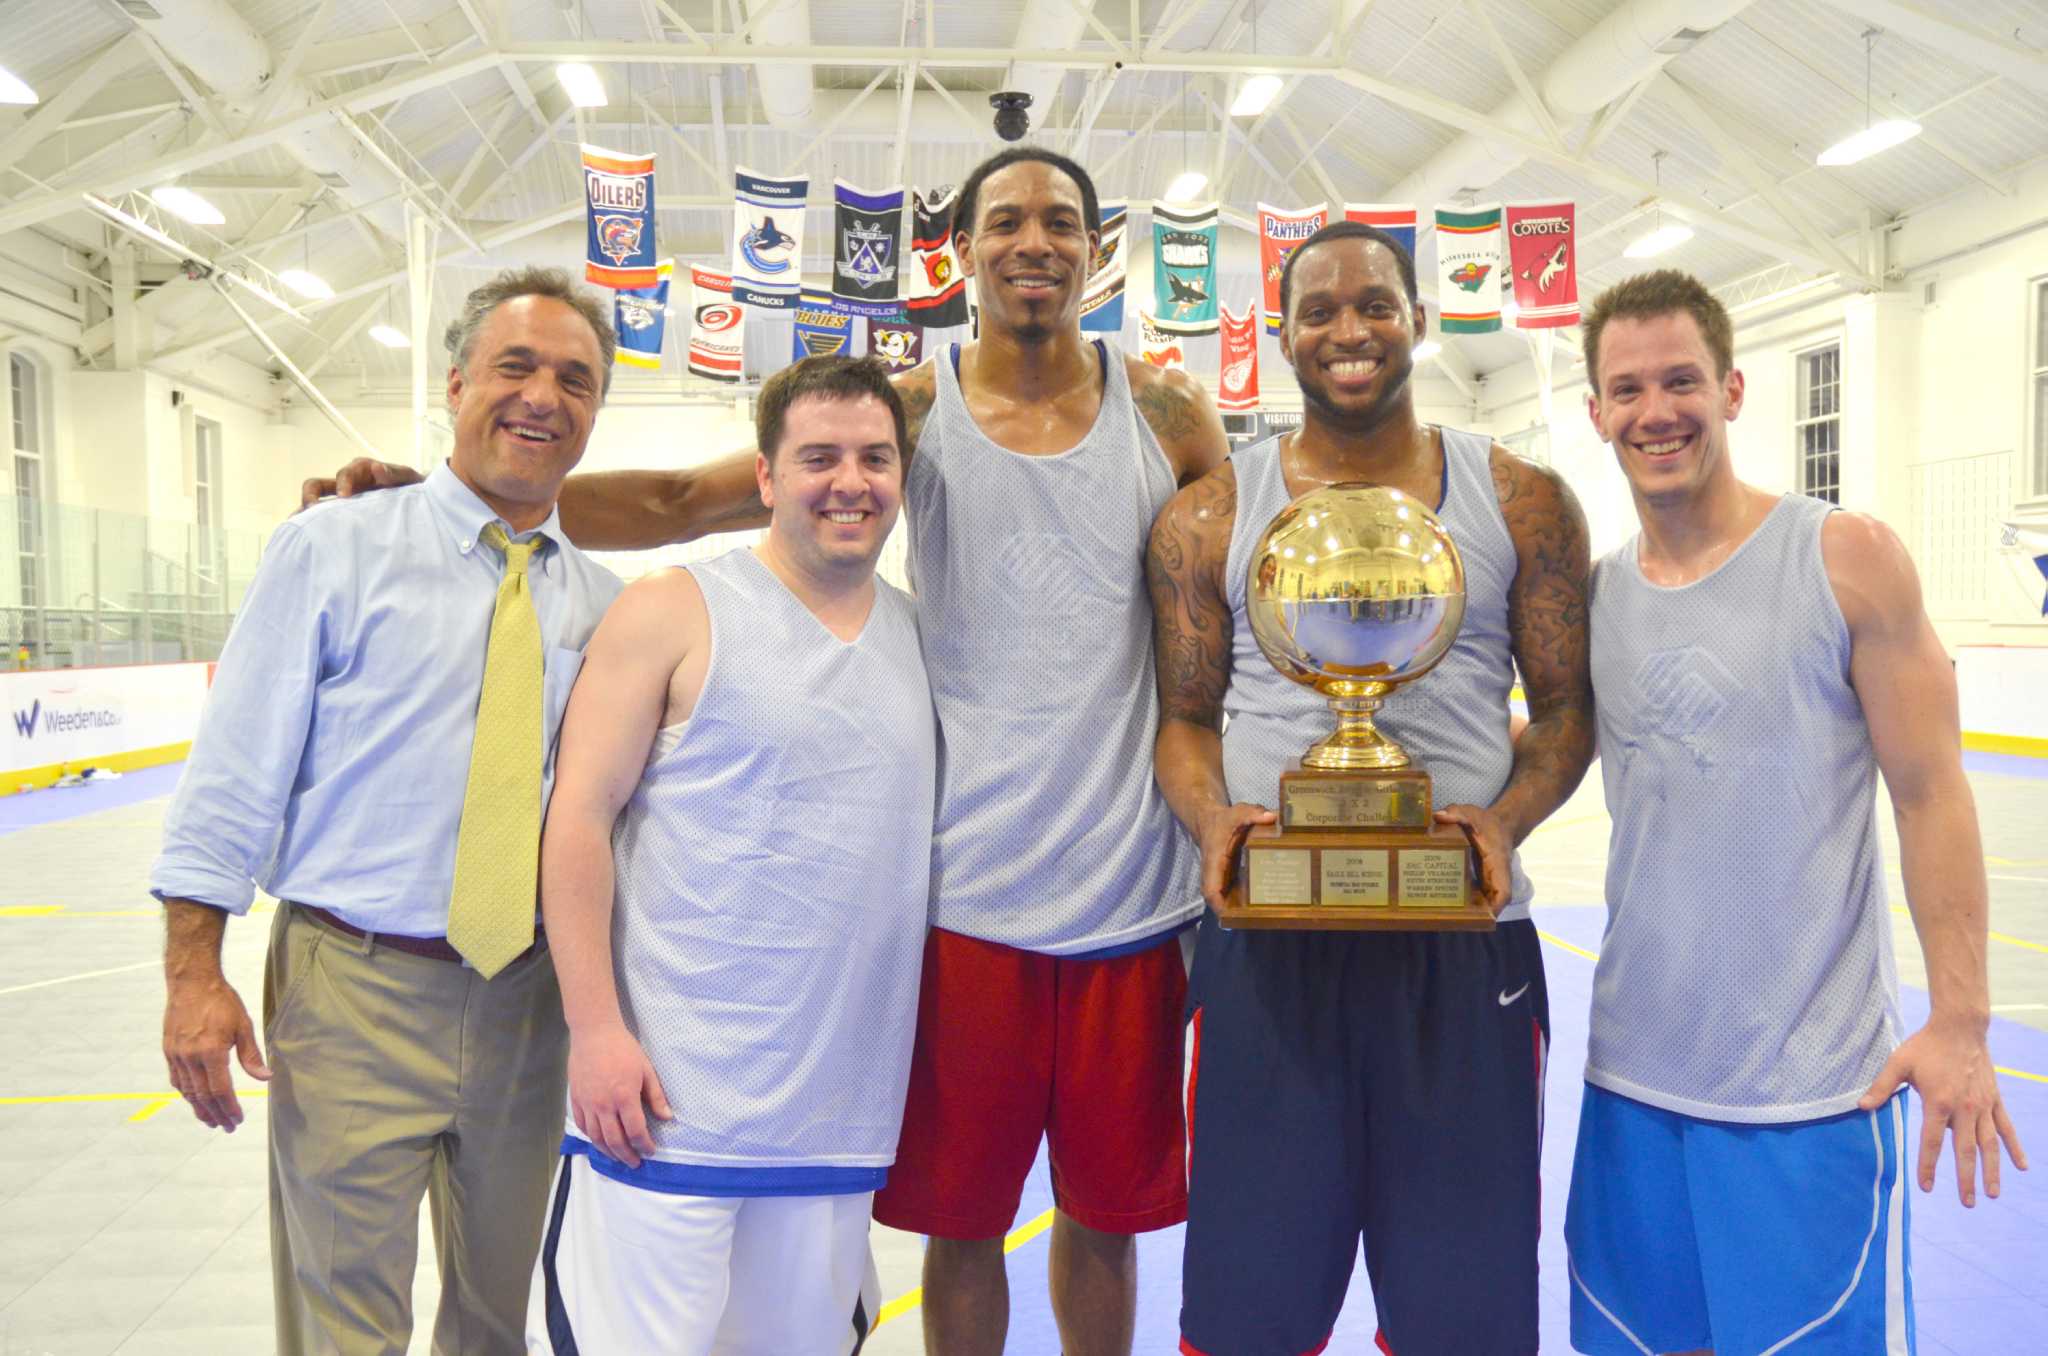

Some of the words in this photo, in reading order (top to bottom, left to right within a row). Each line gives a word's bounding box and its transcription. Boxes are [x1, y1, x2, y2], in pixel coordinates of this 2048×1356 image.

[591, 176, 645, 208] OILERS
[1266, 215, 1321, 240] PANTHERS
[1511, 219, 1570, 237] COYOTES
[746, 294, 785, 306] CANUCKS
[795, 309, 850, 329] BLUES
[1264, 412, 1303, 425] VISITOR
